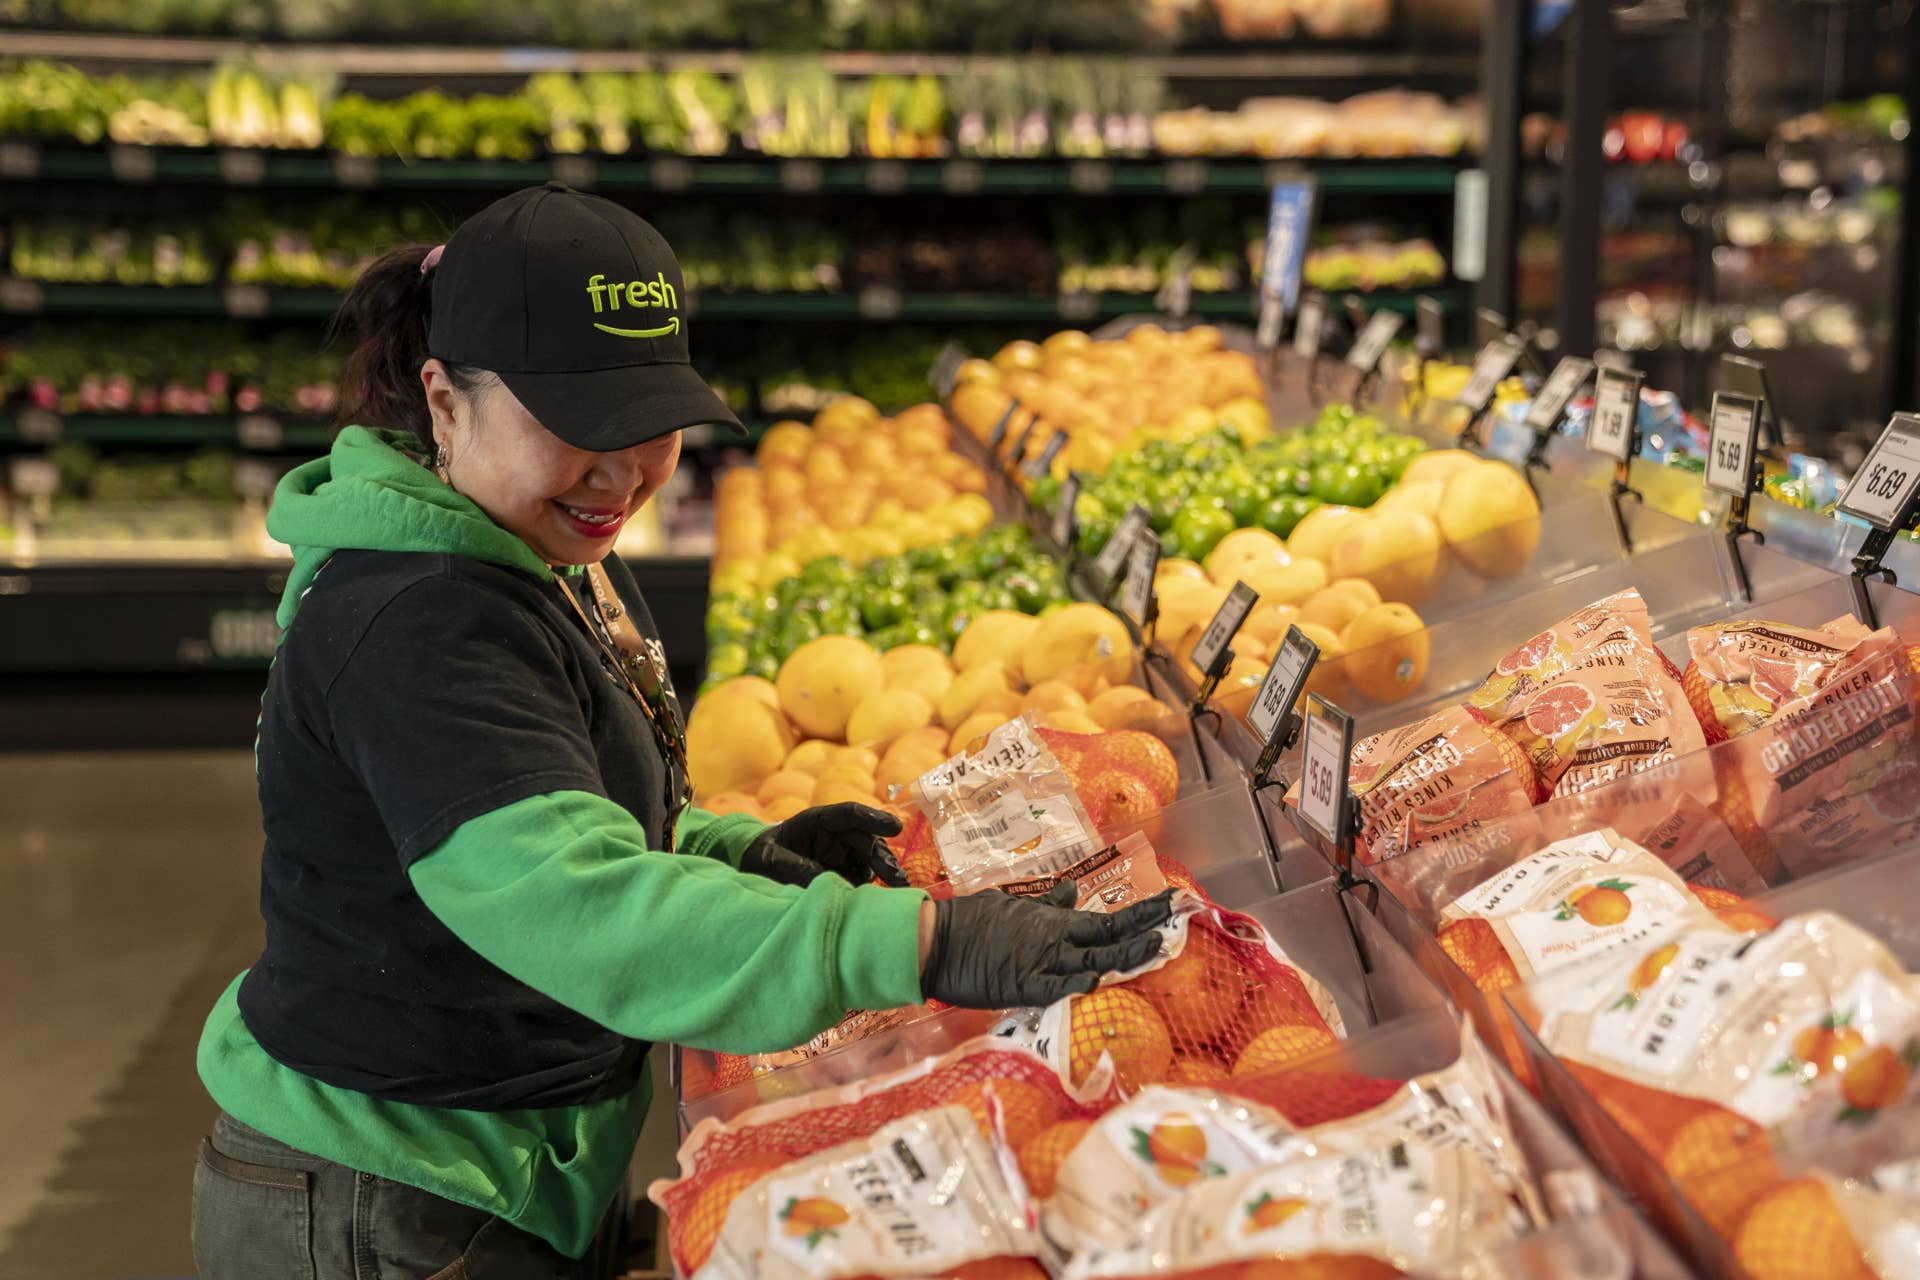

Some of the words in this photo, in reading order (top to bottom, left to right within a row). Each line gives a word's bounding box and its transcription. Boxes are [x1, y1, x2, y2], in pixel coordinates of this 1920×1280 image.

[586, 272, 678, 313] fresh
[1716, 439, 1741, 472] $6.69
[1866, 462, 1908, 499] $6.69
[1263, 675, 1286, 716] $6.69
[1824, 670, 1873, 705] RIVER
[1761, 674, 1903, 773] GRAPEFRUIT
[1623, 741, 1660, 752] PREMIUM
[1309, 756, 1333, 808] $5.69
[1404, 773, 1454, 811] KINGS
